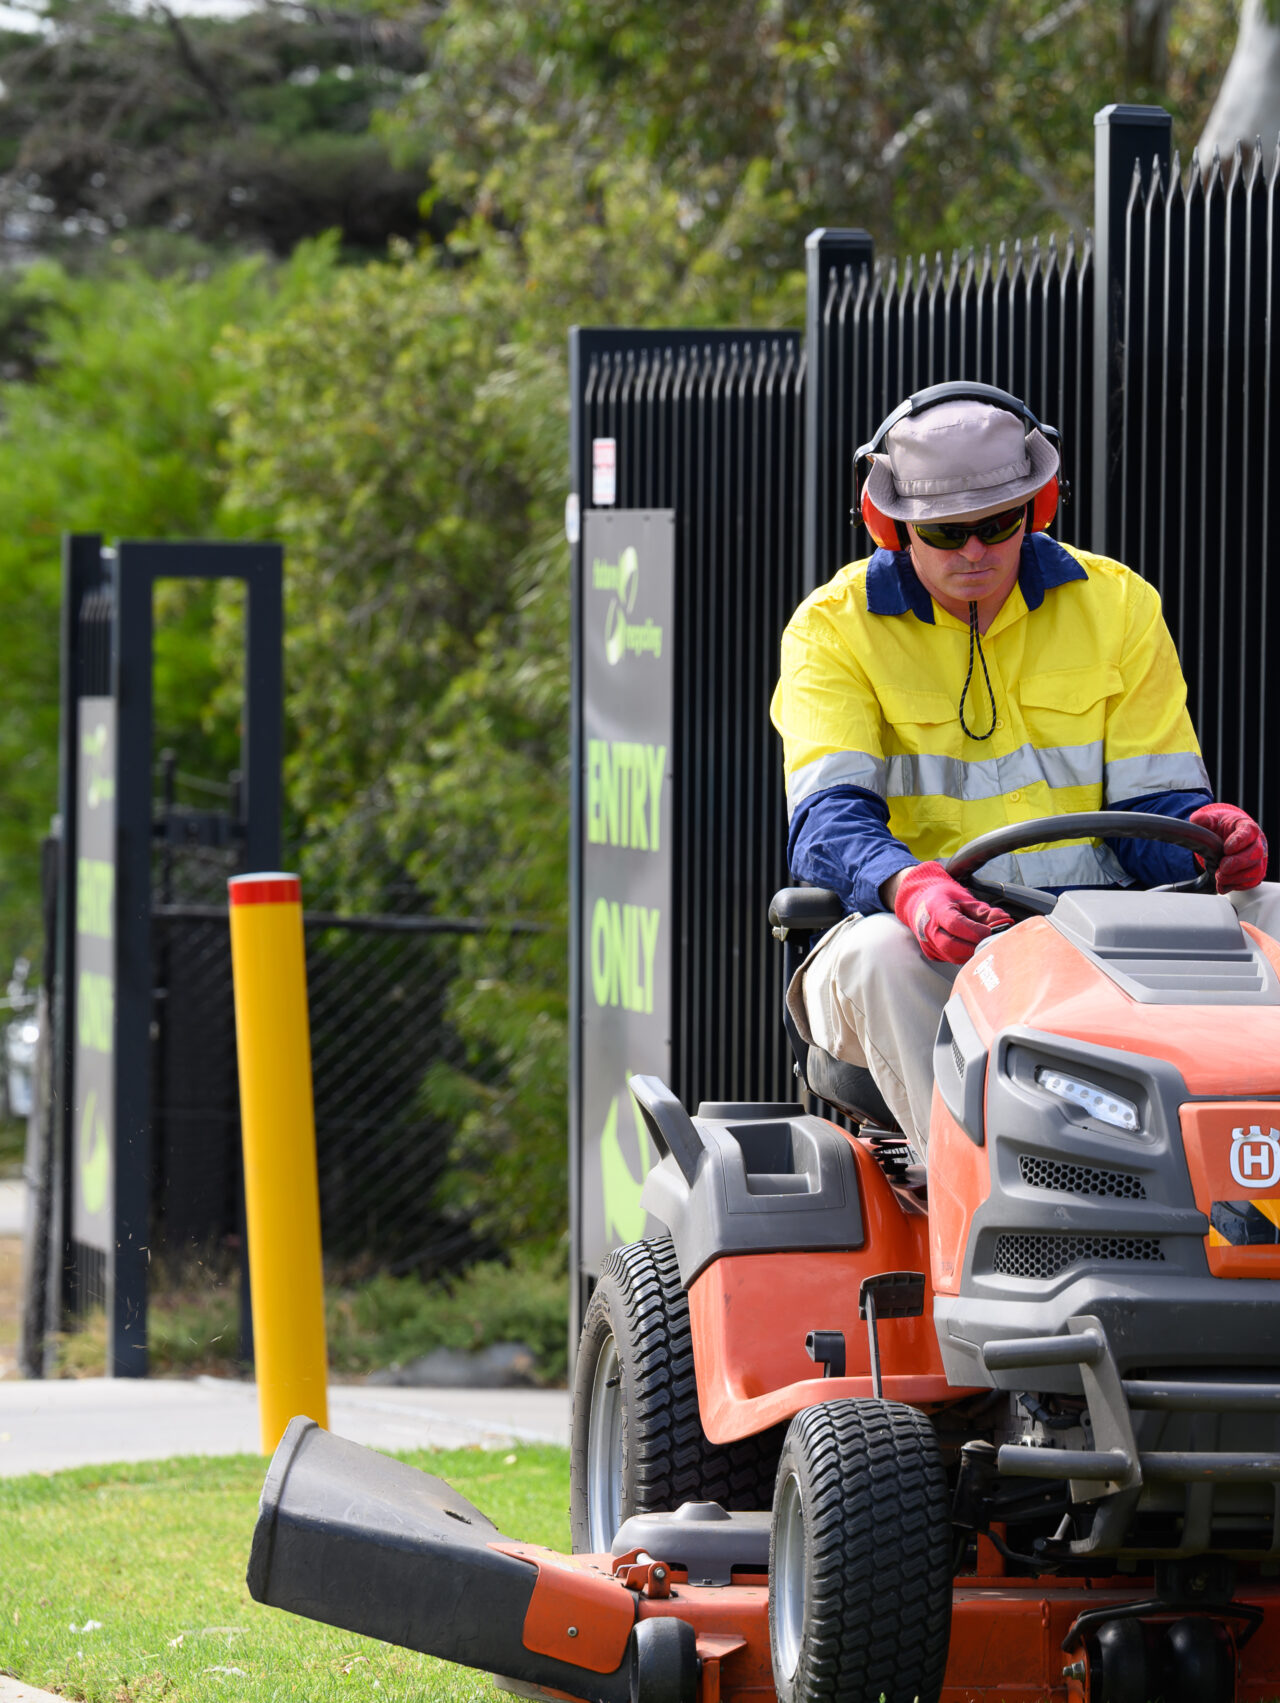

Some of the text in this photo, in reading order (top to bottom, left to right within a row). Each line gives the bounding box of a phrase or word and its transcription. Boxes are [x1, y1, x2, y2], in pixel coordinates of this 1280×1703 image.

[587, 739, 667, 852] ENTRY
[591, 897, 660, 1014] ONLY
[1243, 1144, 1270, 1176] H
